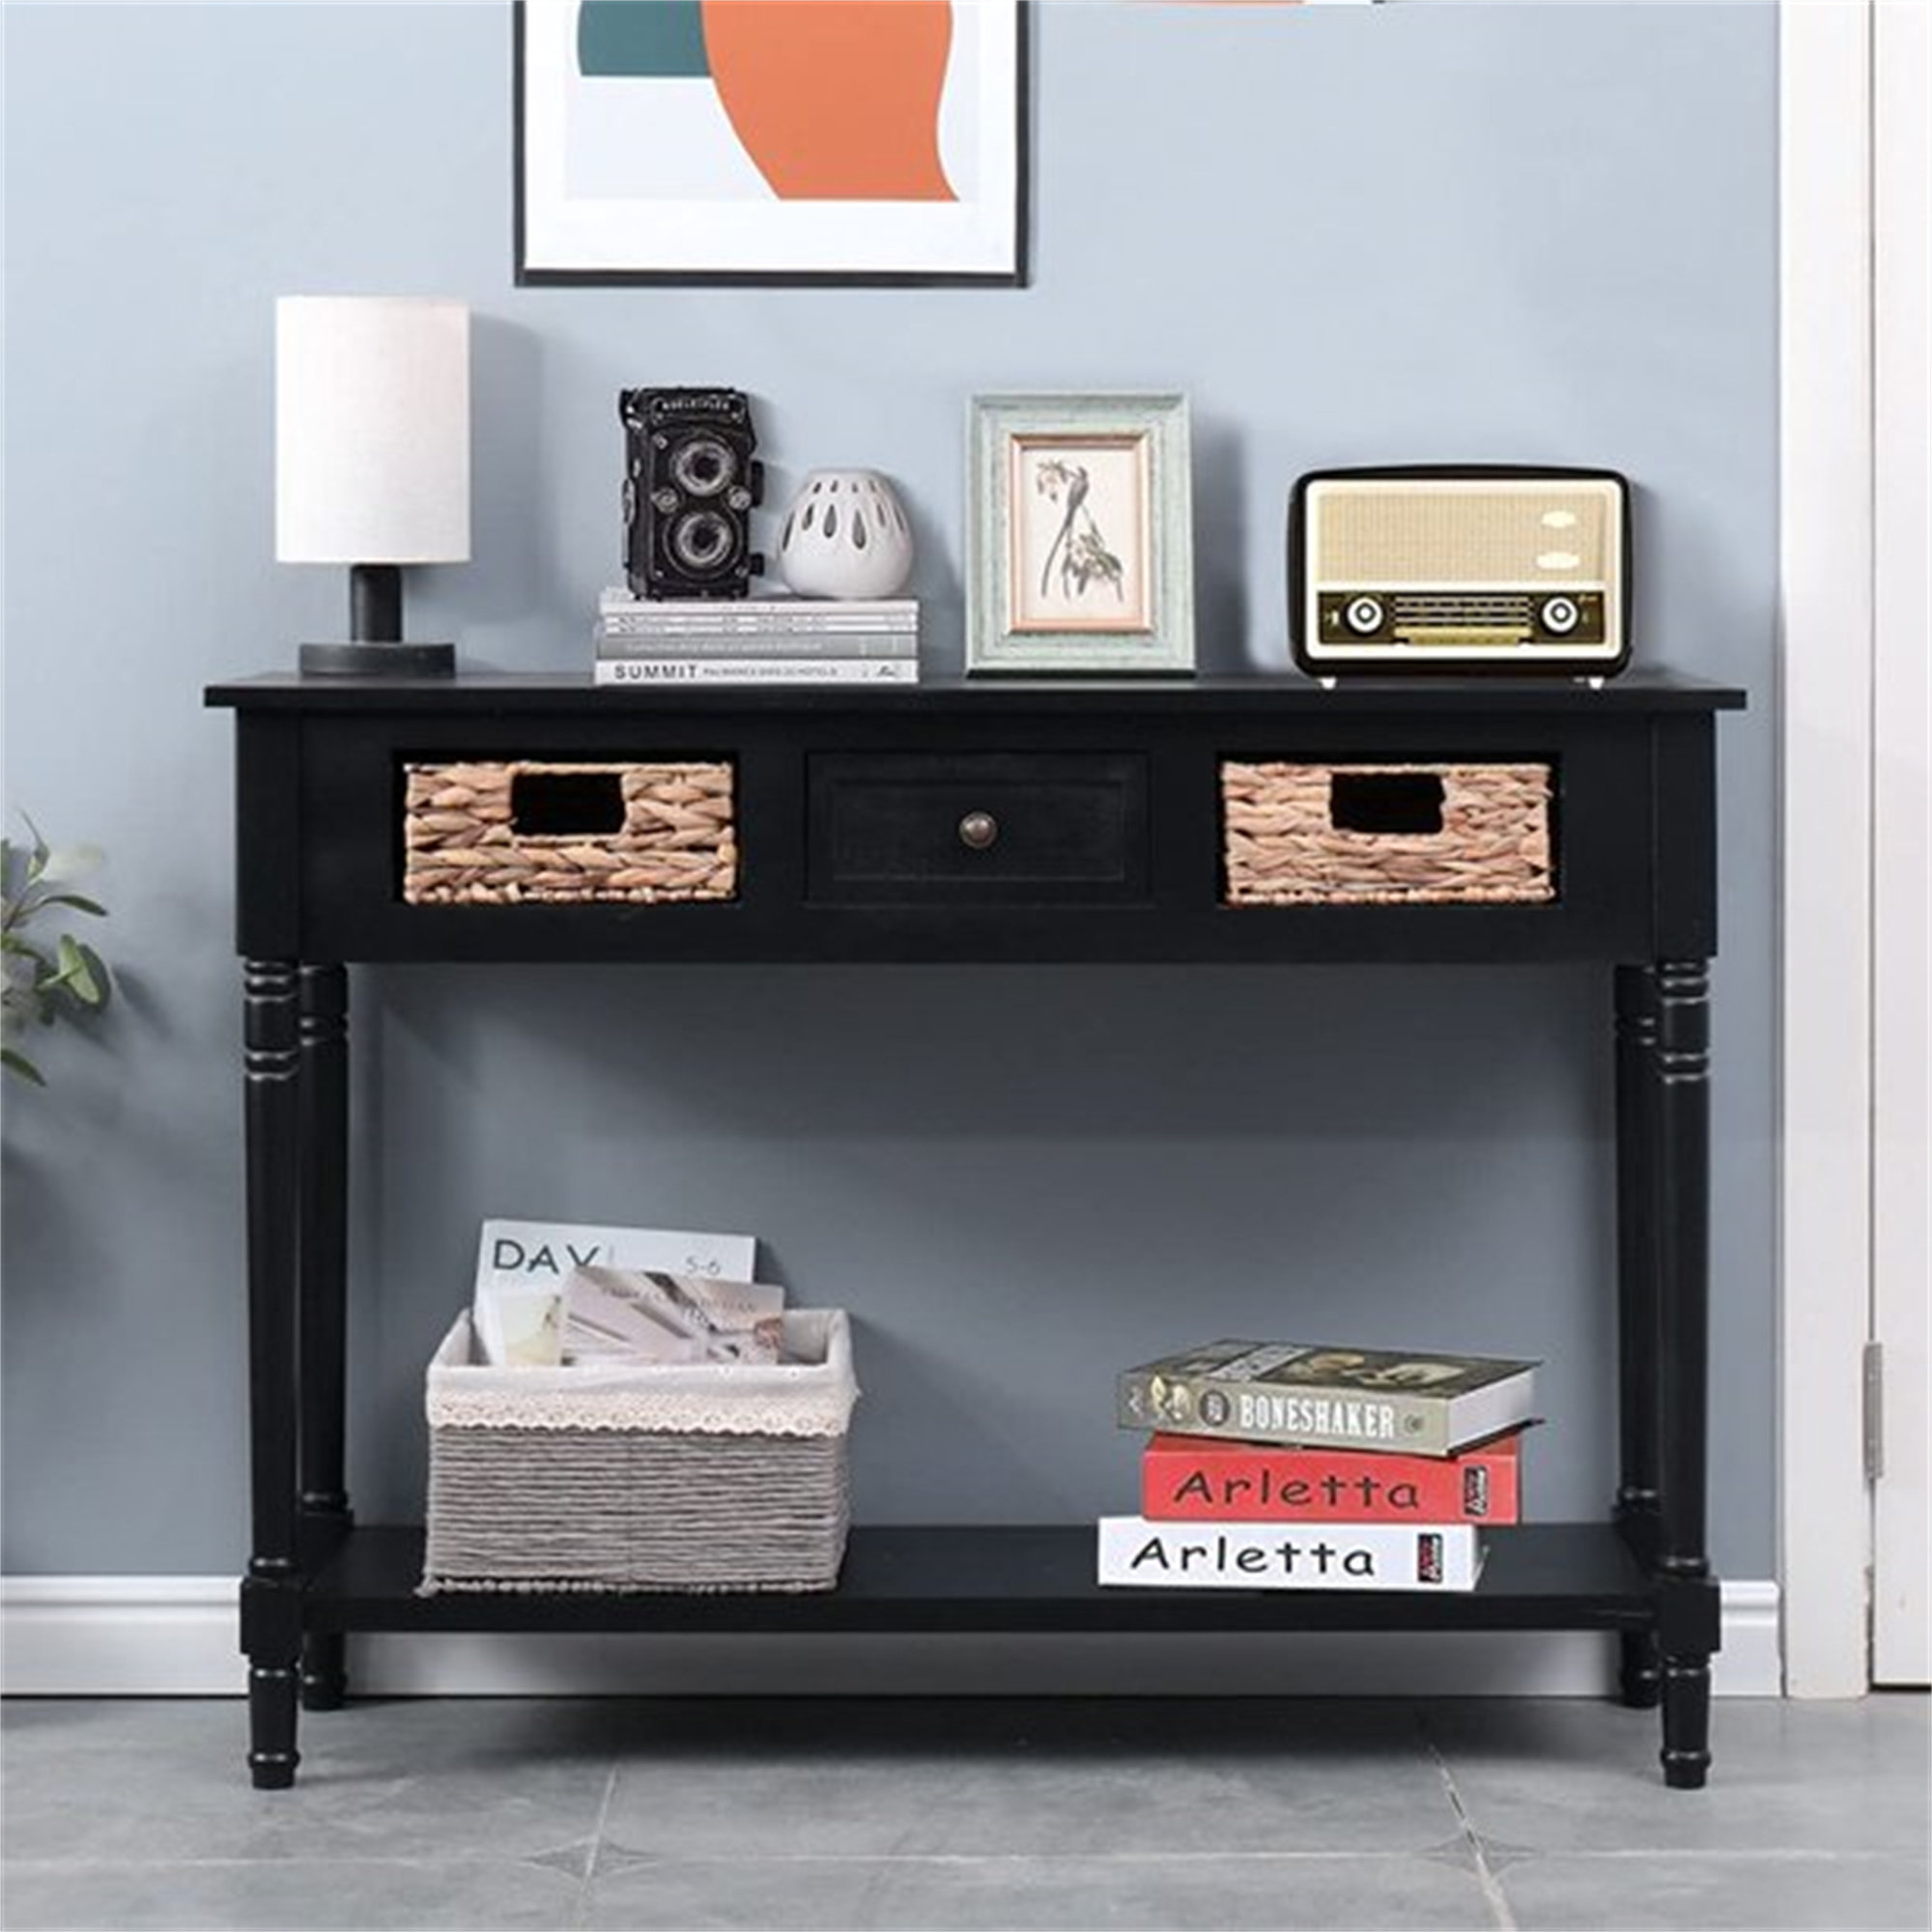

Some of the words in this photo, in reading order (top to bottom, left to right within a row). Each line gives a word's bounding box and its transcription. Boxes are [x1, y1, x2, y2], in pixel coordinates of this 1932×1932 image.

[614, 664, 697, 679] SUMMIT
[1239, 1394, 1396, 1439] BONESHAKER
[1173, 1470, 1419, 1508] Arletta
[1130, 1536, 1376, 1577] Arletta
